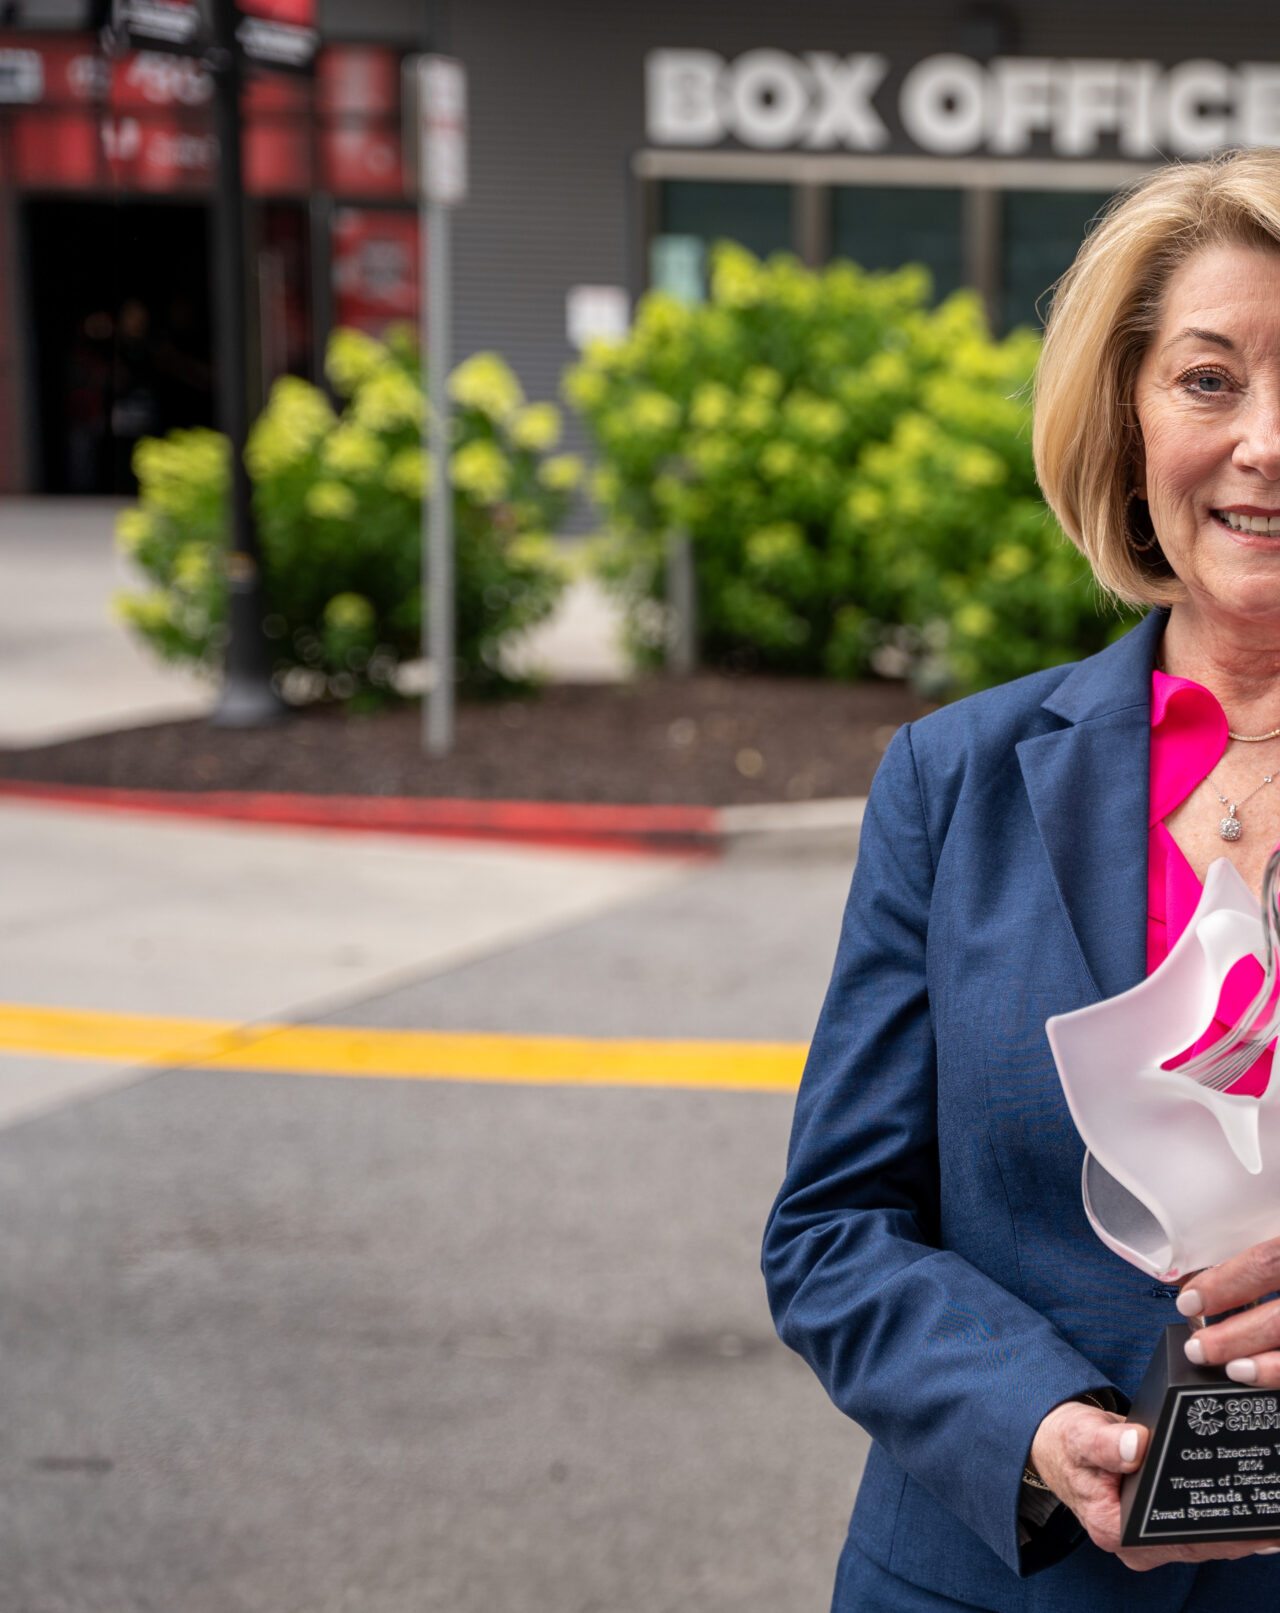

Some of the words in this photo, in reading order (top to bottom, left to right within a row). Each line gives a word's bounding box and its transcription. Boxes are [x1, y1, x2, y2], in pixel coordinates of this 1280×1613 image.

[644, 46, 892, 152] BOX
[1224, 1398, 1278, 1415] COBB
[1181, 1448, 1213, 1460] Cobb
[1216, 1446, 1271, 1459] Executive
[1238, 1460, 1264, 1472] 2024
[1170, 1476, 1215, 1490] Woman
[1218, 1474, 1231, 1487] of
[1189, 1489, 1243, 1505] Rhonda
[1150, 1507, 1185, 1520] Award
